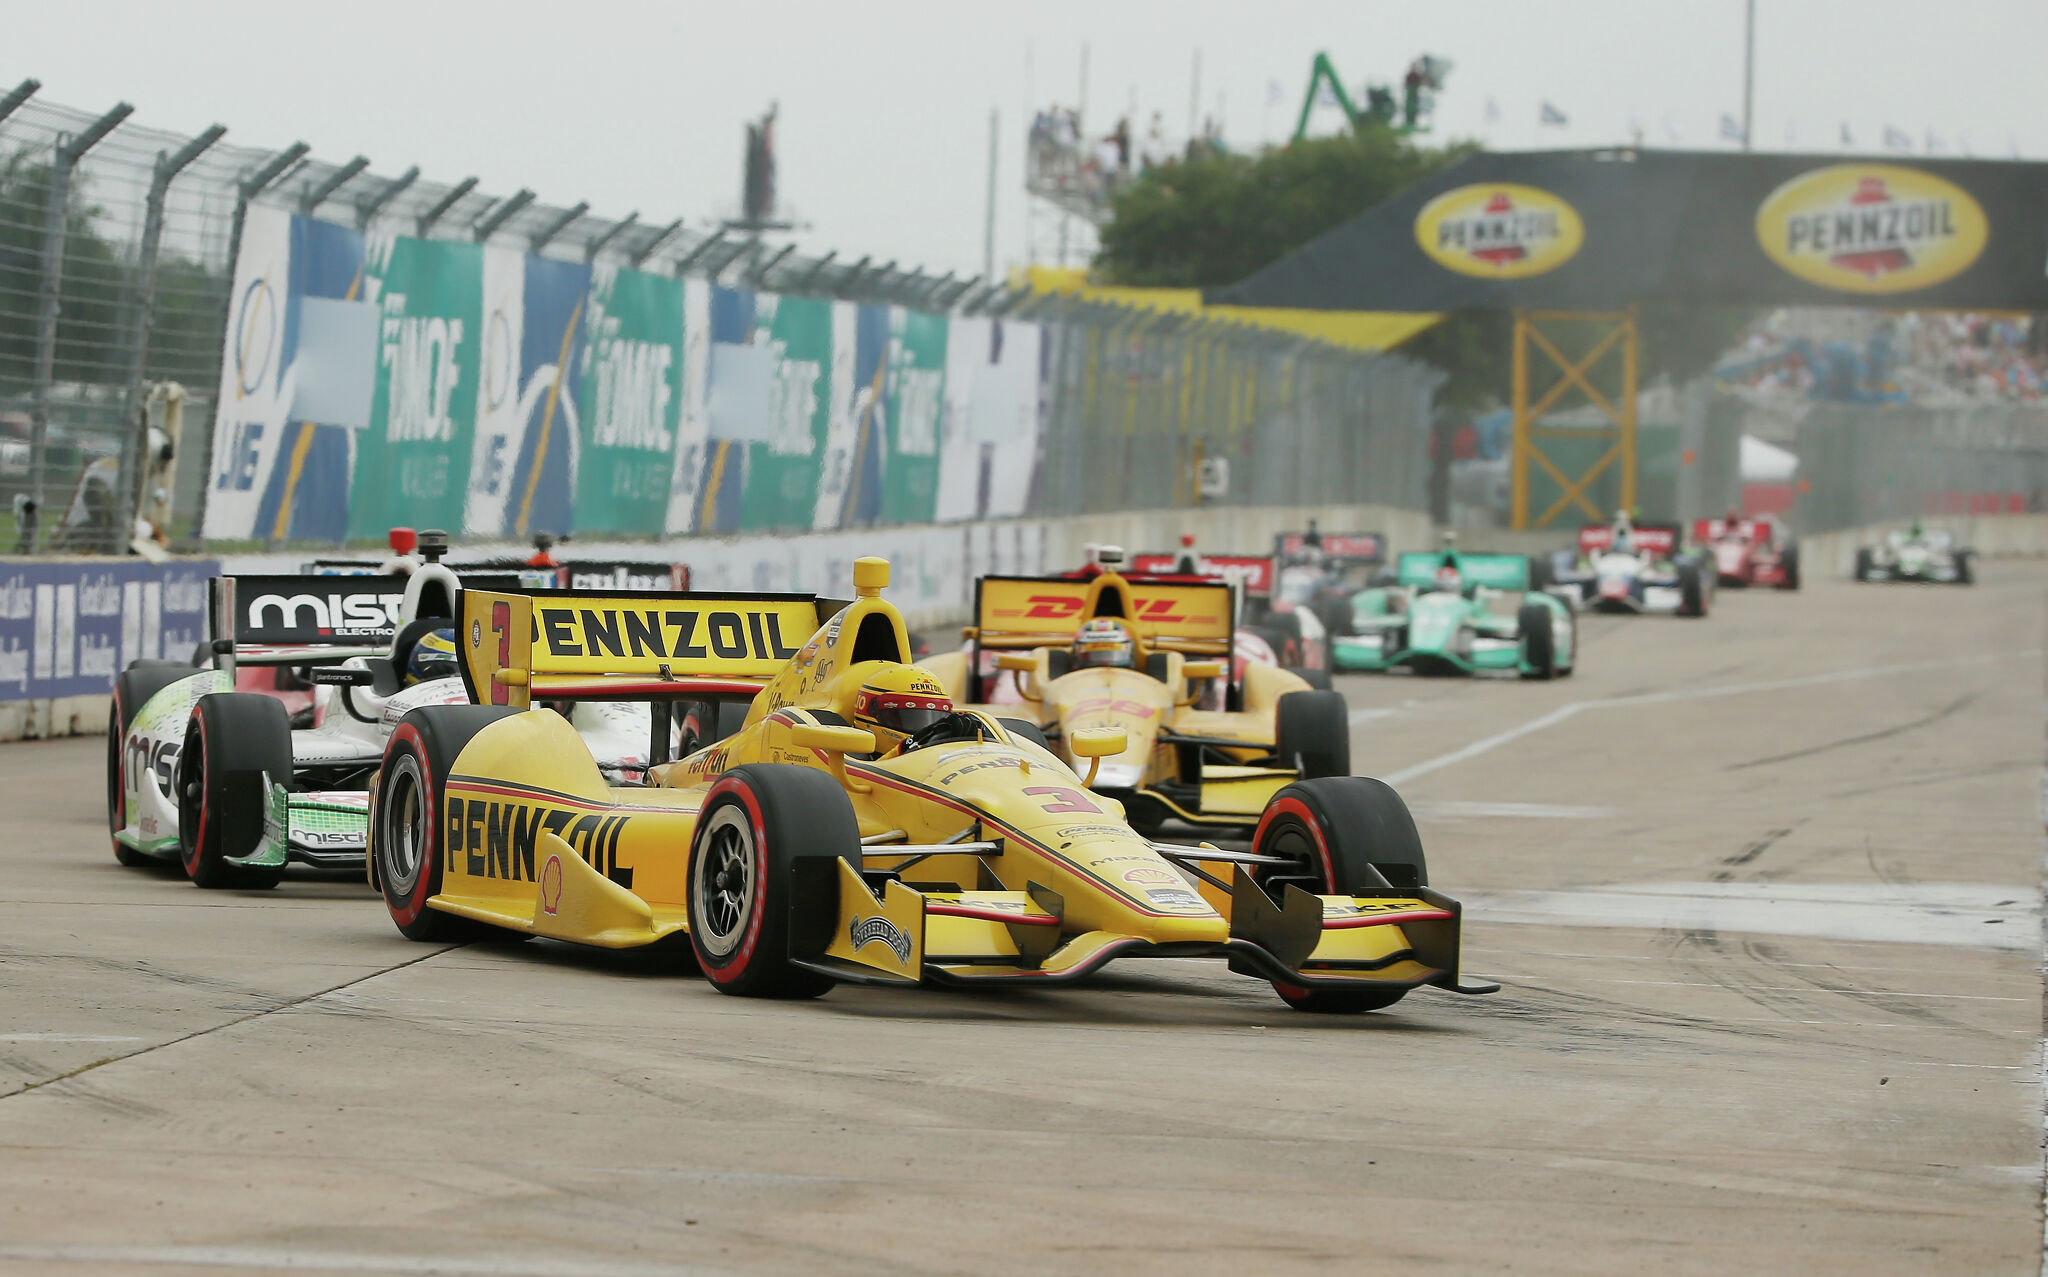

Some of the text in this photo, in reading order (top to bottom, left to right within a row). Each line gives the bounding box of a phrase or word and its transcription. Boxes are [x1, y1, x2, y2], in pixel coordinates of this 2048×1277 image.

[1437, 211, 1562, 249] PENNZOIL
[1785, 200, 1958, 255] PENNZOIL
[1023, 595, 1187, 623] DL
[532, 608, 801, 659] ENNZOIL
[316, 672, 353, 681] plantronics
[1022, 786, 1104, 814] 3
[855, 922, 889, 945] OVERHEAD
